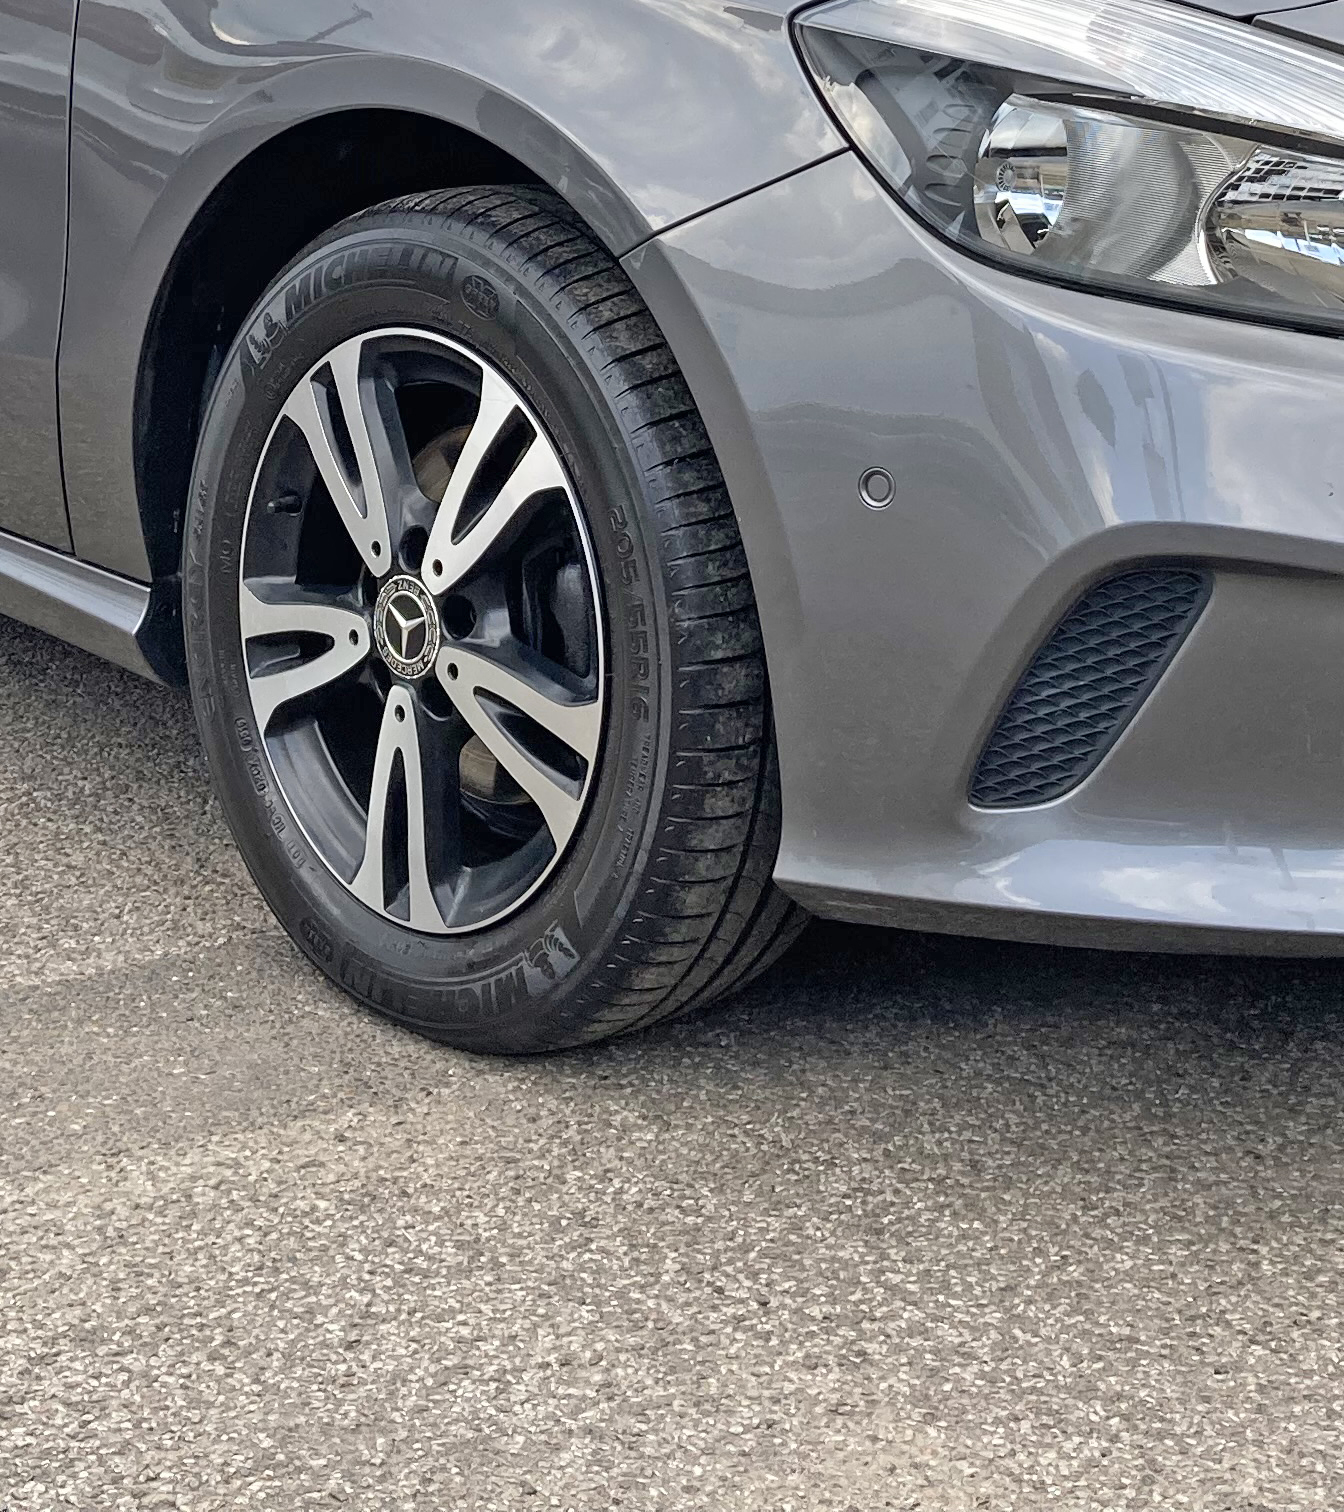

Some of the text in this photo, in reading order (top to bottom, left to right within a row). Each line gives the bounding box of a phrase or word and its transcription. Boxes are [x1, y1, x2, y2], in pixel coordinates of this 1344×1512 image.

[284, 245, 458, 323] MICHELIN
[397, 579, 421, 596] BENZ
[382, 646, 425, 676] MERCEDES
